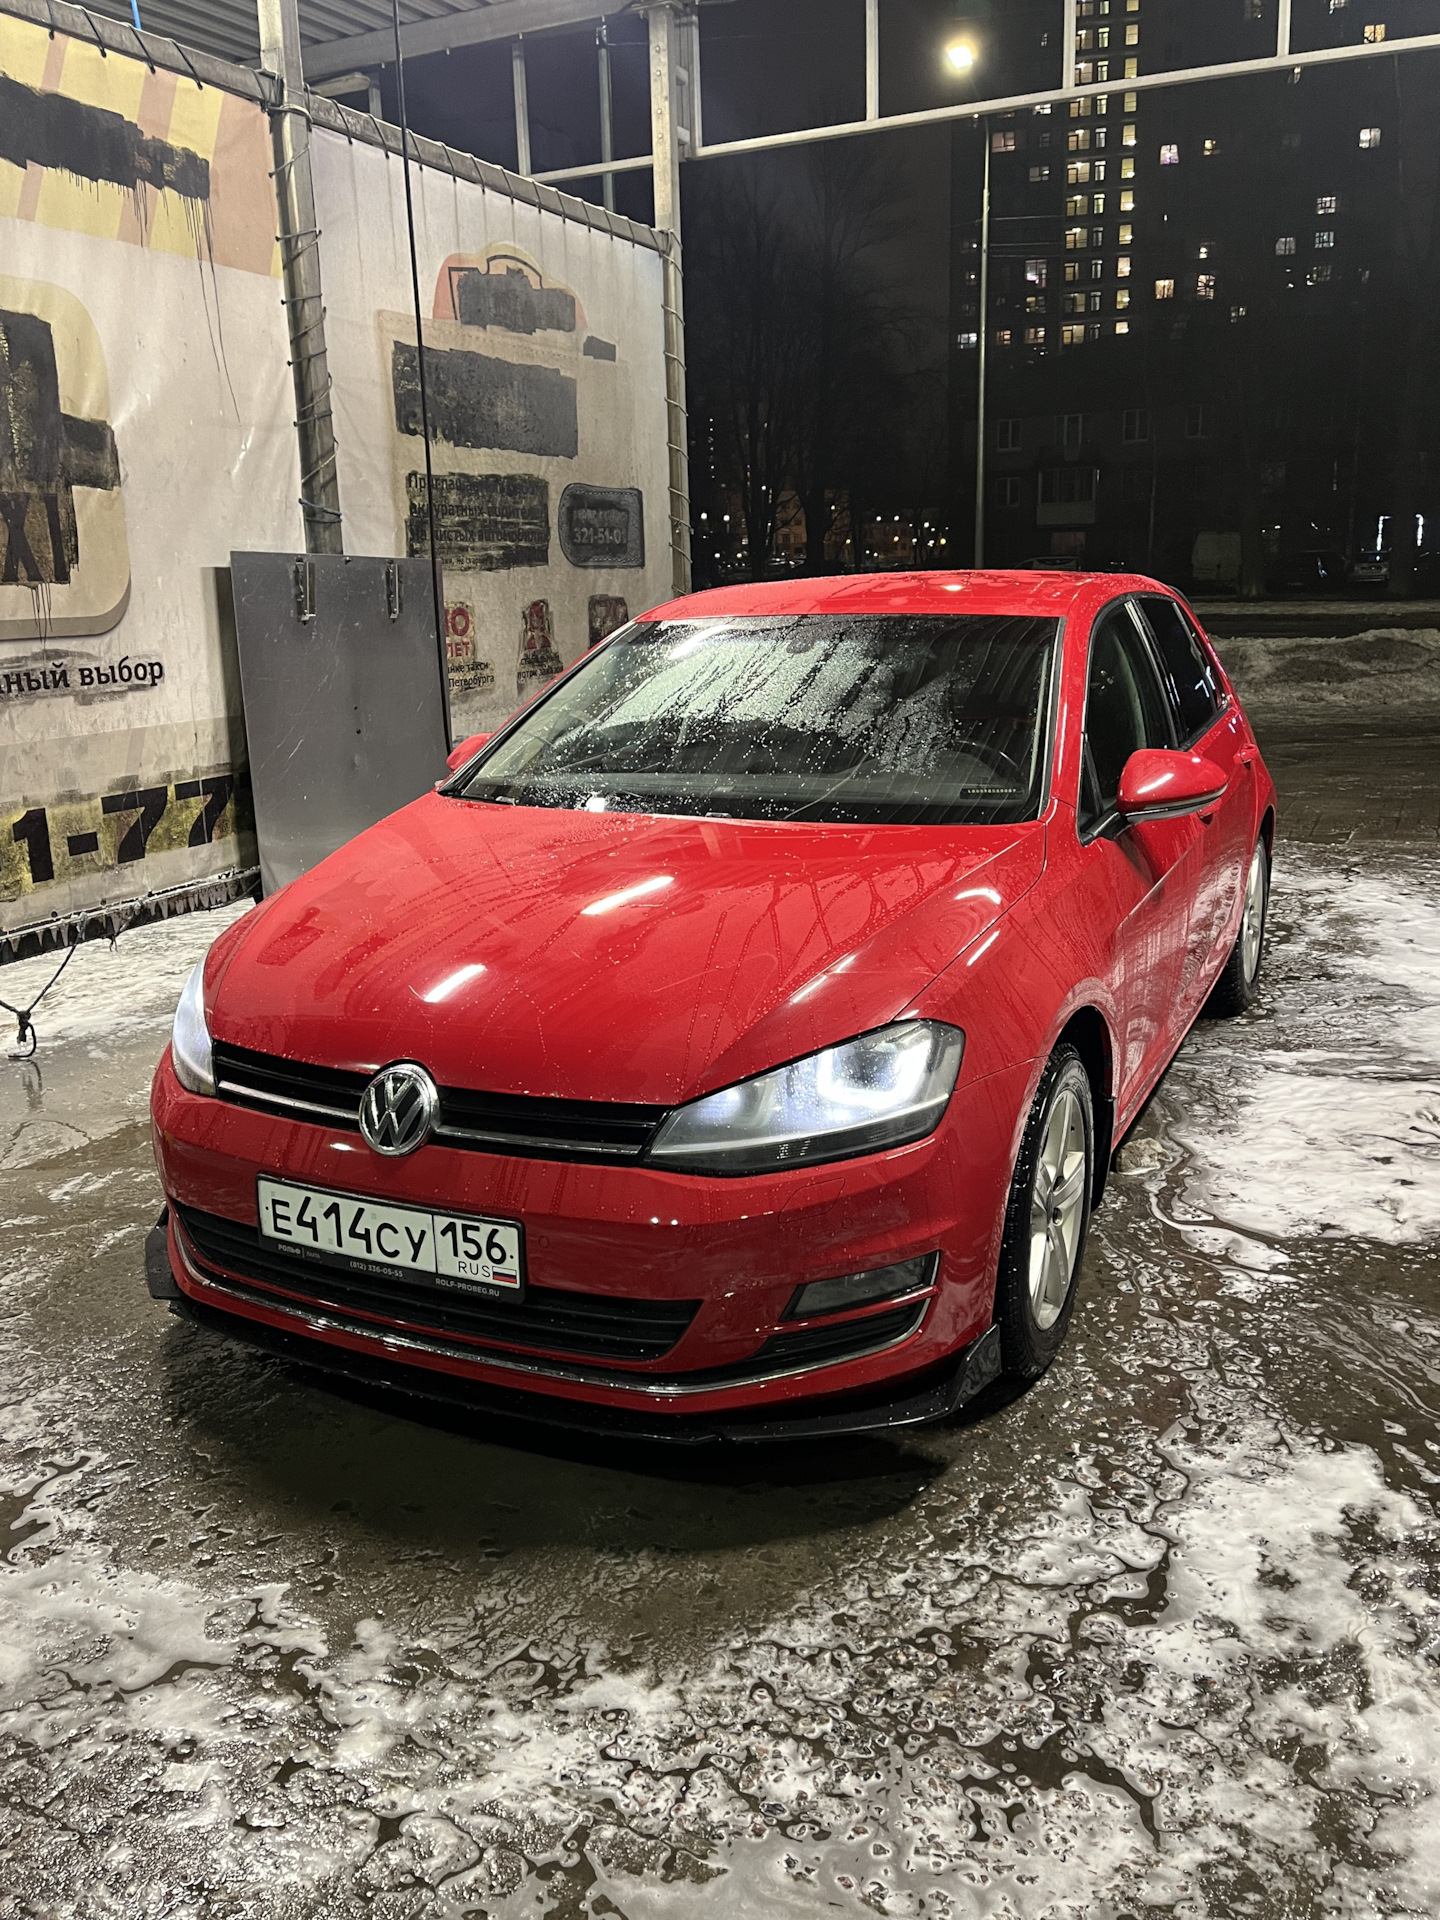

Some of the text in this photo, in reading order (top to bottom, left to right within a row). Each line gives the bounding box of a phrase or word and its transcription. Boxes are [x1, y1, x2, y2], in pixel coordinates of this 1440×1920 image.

[410, 503, 484, 519] акуратных
[0, 655, 164, 693] ный выбор
[278, 1243, 301, 1255] РОЛЬФ
[440, 1221, 507, 1265] 156
[458, 1260, 491, 1278] RUS
[435, 1278, 500, 1297] ROLF-PROBEG.RU
